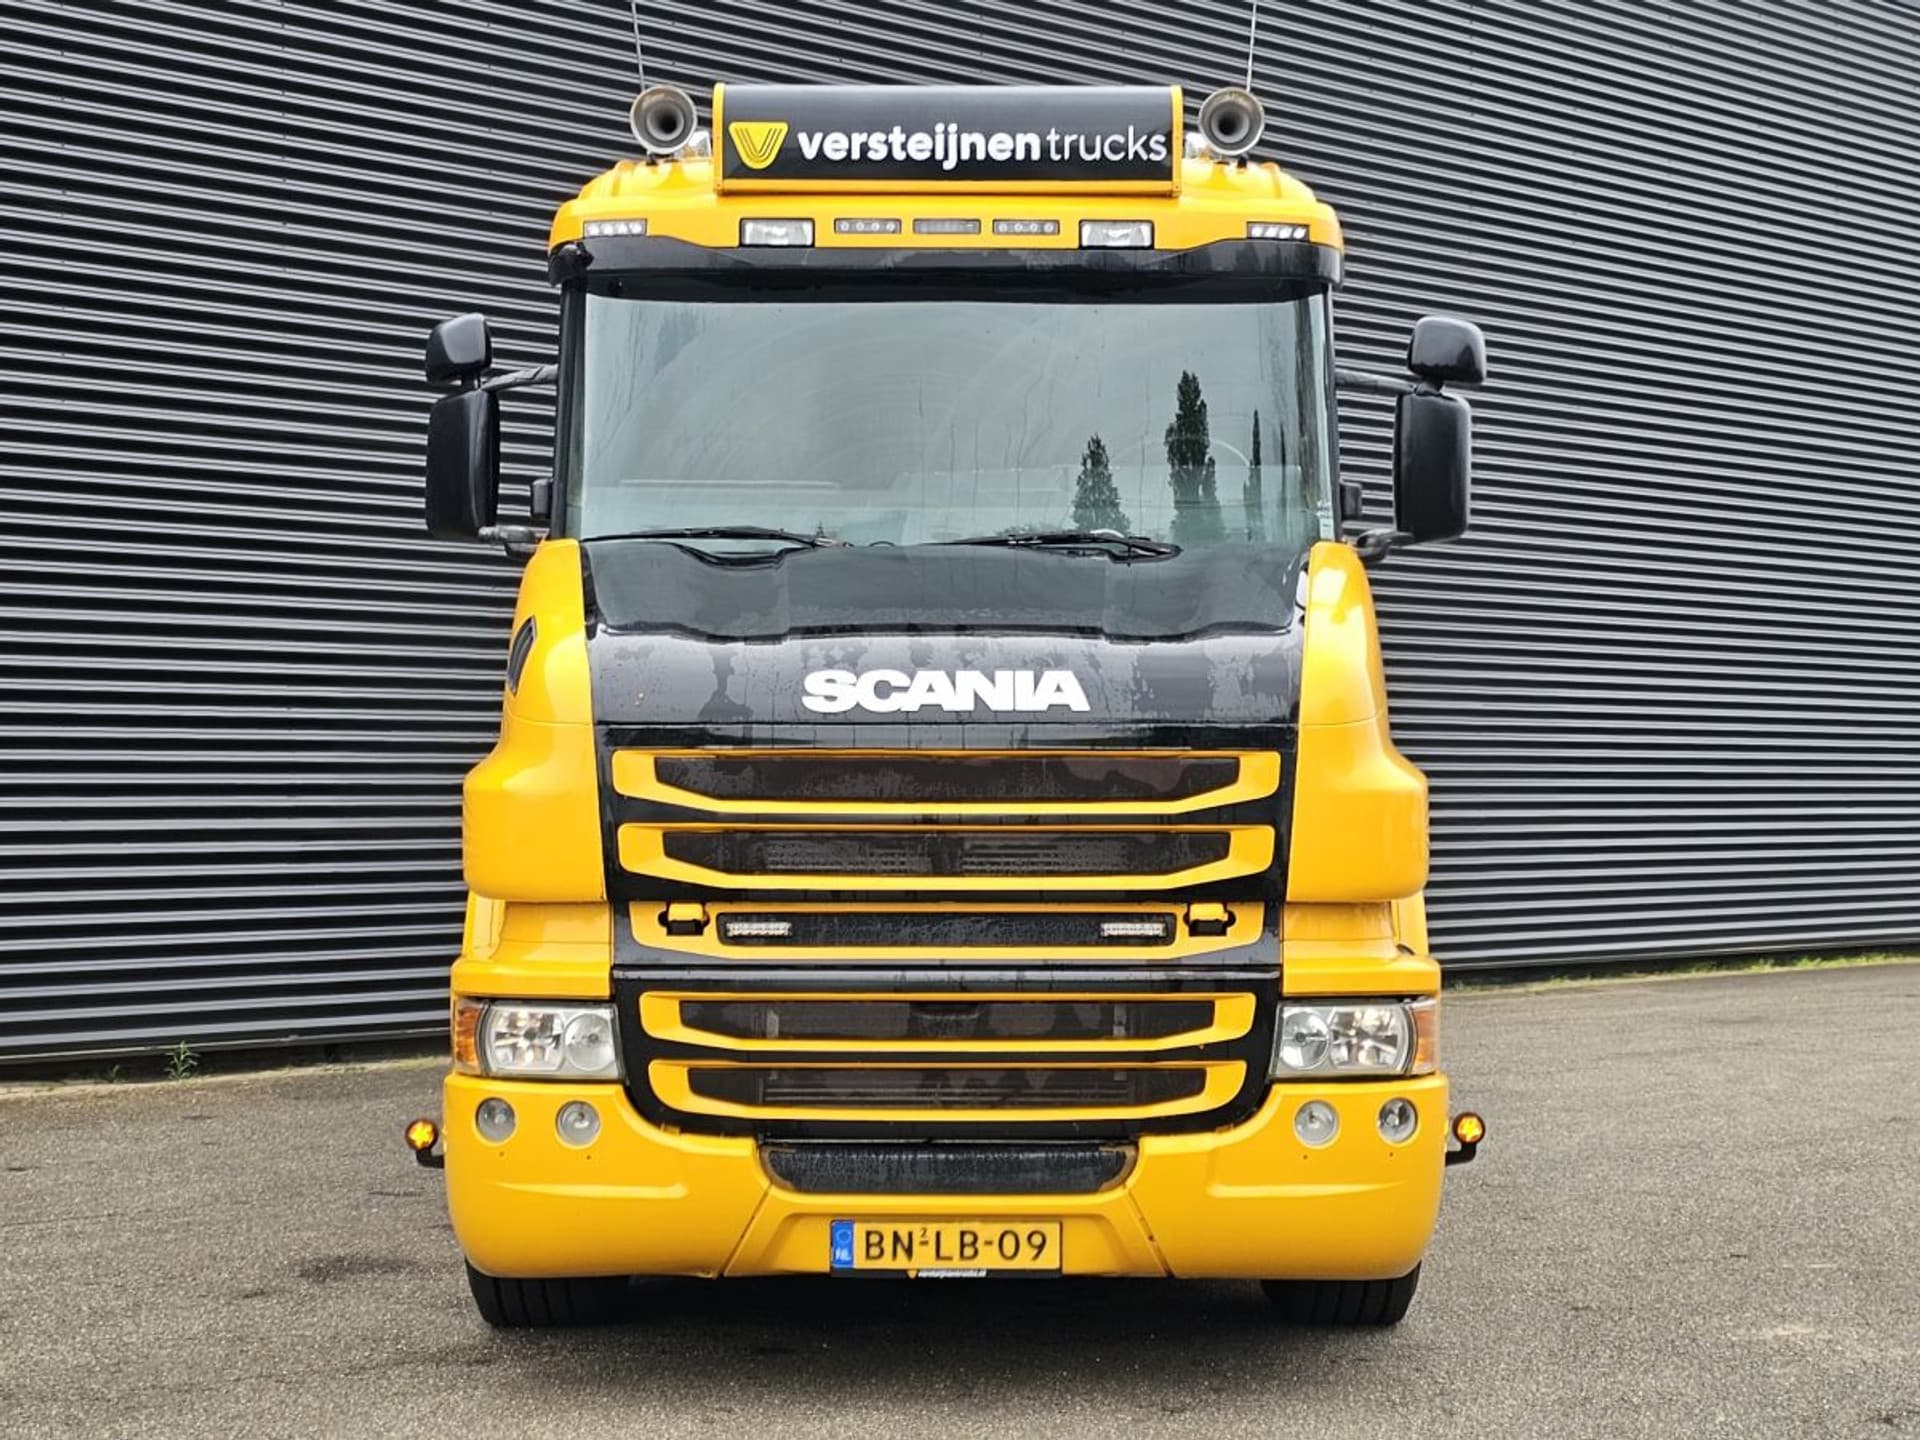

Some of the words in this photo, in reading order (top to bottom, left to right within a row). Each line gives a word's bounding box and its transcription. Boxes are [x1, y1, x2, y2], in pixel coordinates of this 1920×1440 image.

[797, 122, 1041, 170] versteijnen
[1046, 125, 1167, 161] trucks
[801, 669, 1091, 713] SCANIA
